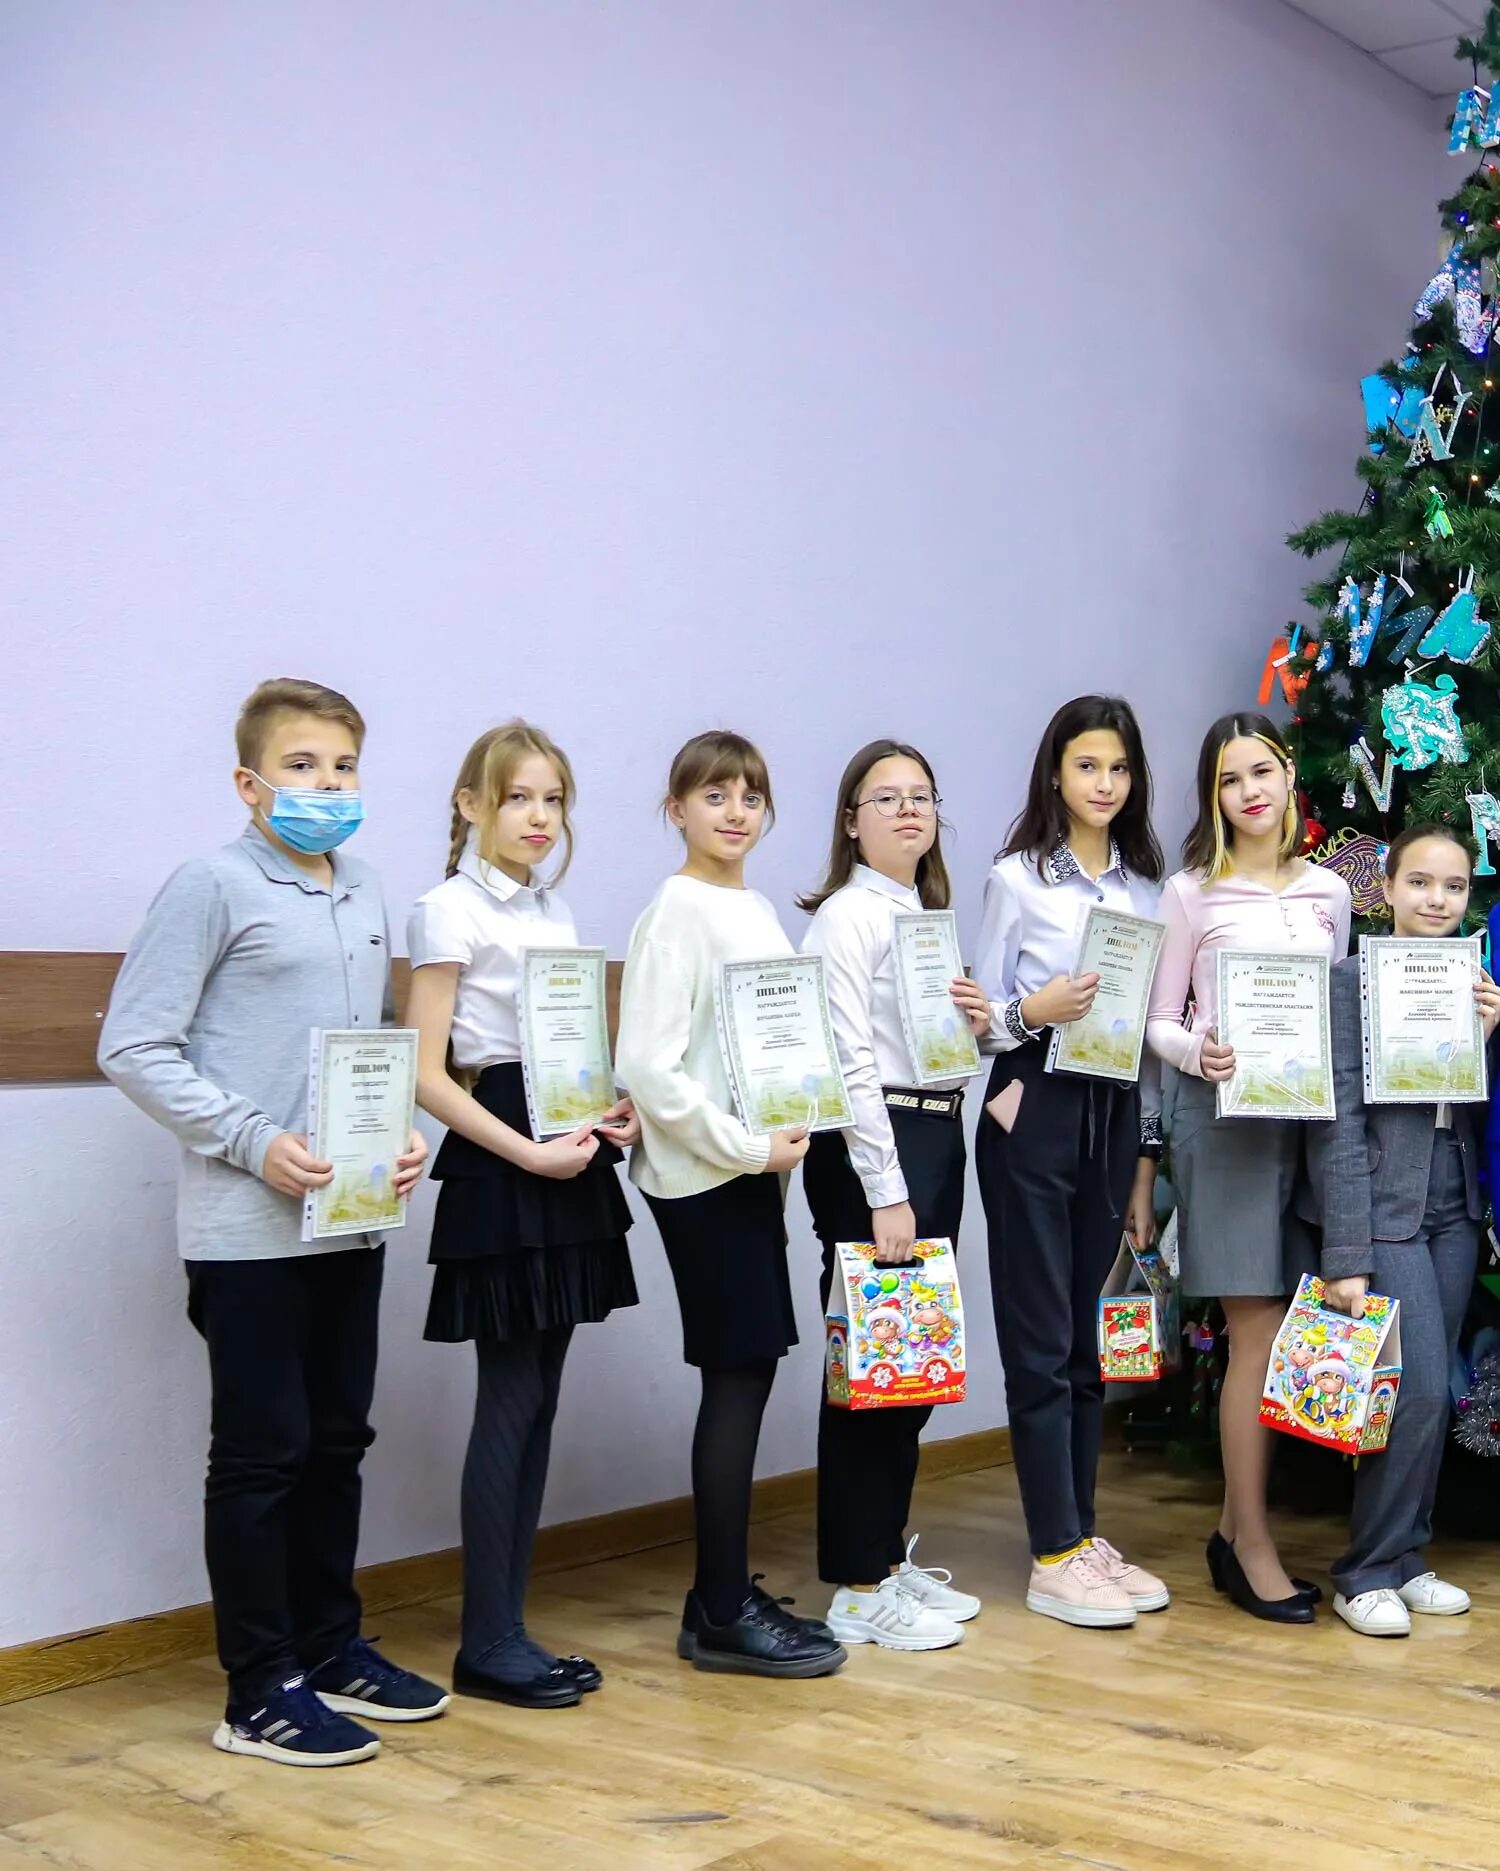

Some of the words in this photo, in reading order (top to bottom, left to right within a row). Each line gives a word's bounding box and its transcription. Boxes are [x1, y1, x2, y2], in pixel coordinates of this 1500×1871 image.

[1403, 965, 1448, 973] ДИПЛОМ
[1252, 978, 1297, 988] ДИПЛОМ
[755, 985, 797, 998] ДИПЛОМ
